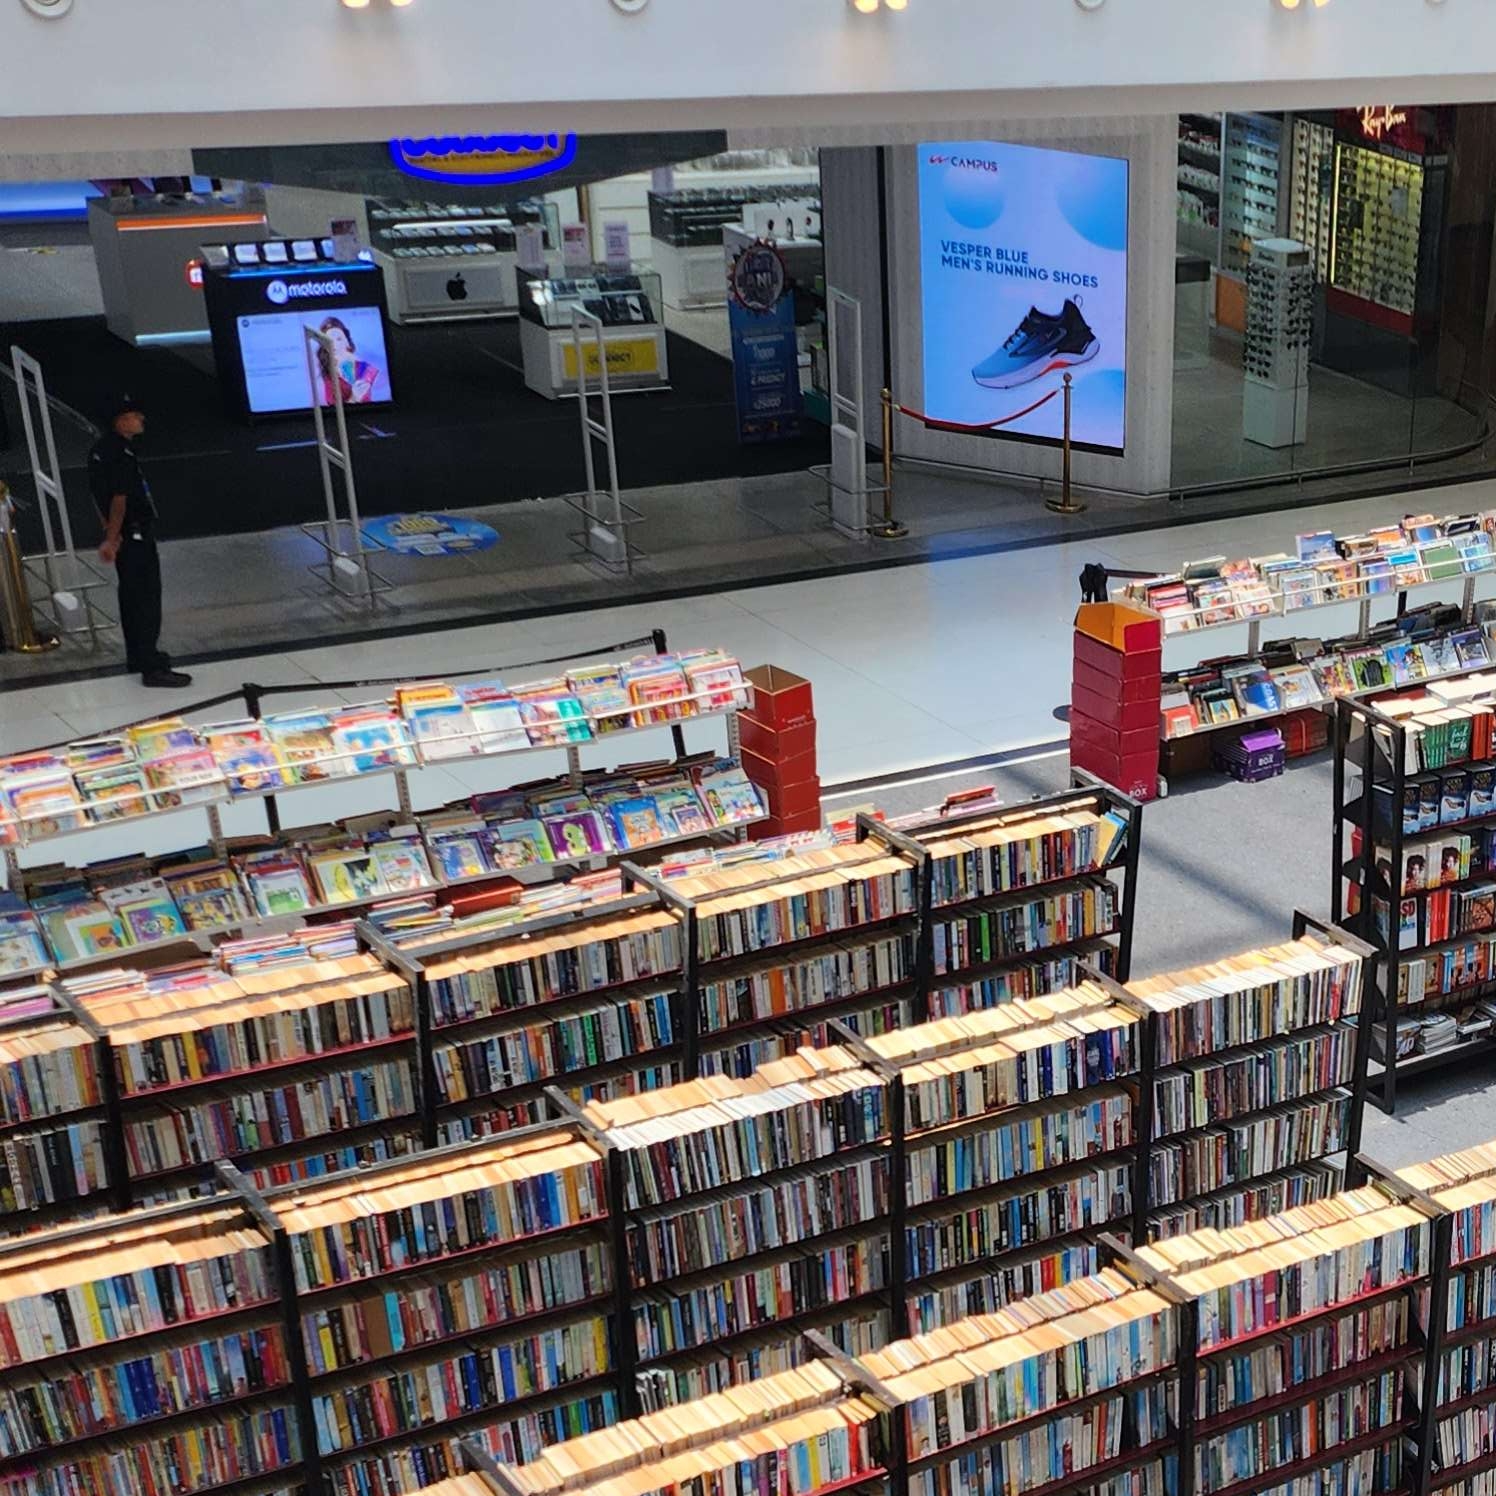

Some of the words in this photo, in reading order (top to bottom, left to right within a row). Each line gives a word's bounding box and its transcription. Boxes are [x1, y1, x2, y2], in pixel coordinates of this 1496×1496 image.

[951, 156, 998, 172] CAMPUS
[941, 240, 992, 260] VESPER
[996, 249, 1029, 265] BLUE
[941, 256, 983, 272] MEN'S
[986, 262, 1049, 281] RUNNING
[1052, 271, 1099, 288] SHOES
[288, 280, 347, 298] motorola
